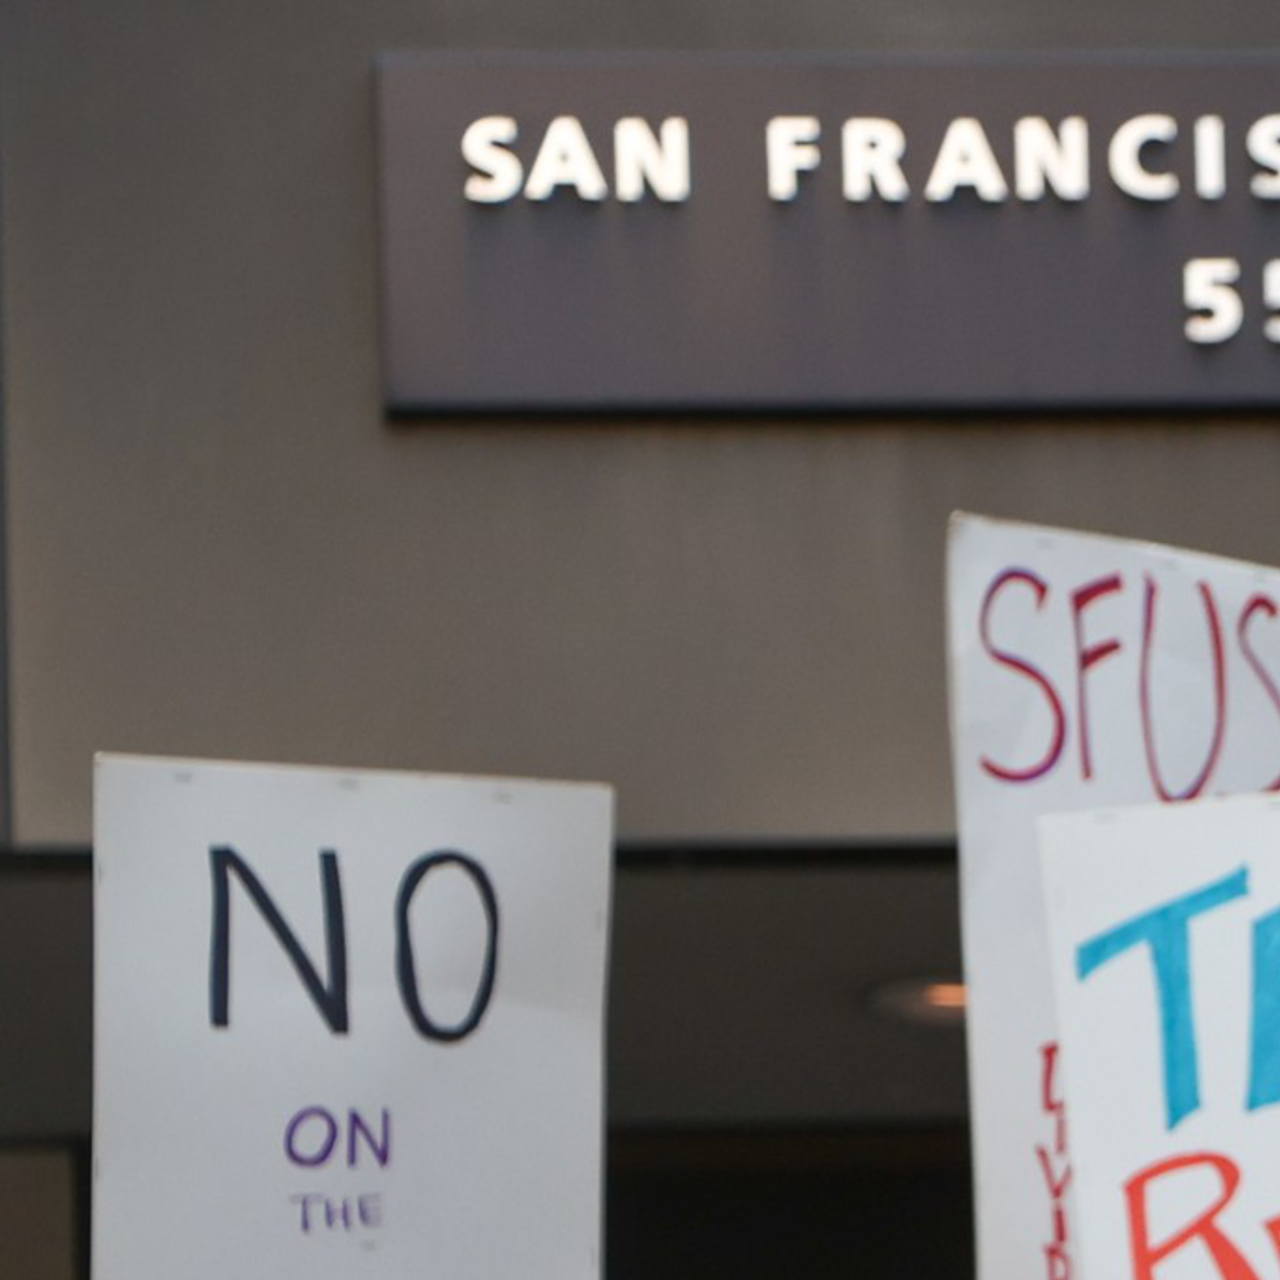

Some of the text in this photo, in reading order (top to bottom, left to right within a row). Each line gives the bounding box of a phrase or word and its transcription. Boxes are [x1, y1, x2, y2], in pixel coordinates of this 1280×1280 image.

[462, 117, 689, 201] SAN
[209, 845, 499, 1044] NO
[284, 1107, 390, 1168] ON
[289, 1192, 384, 1235] THE
